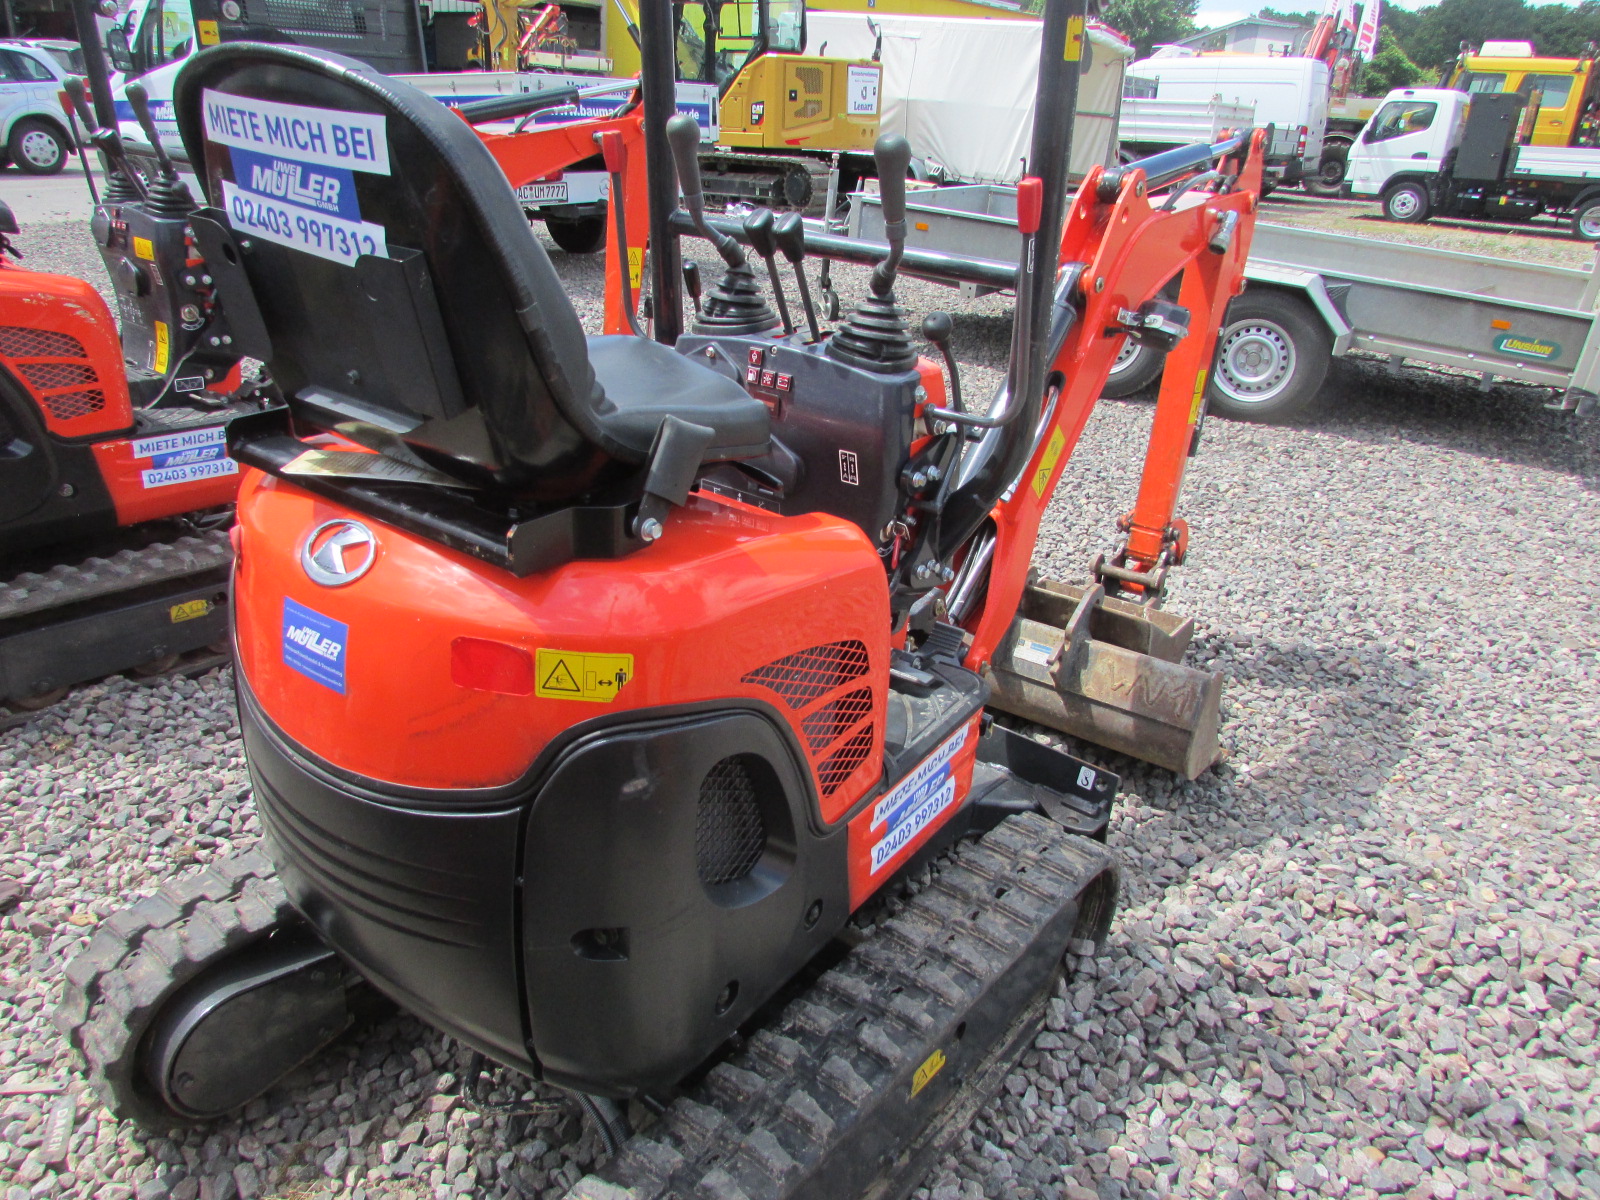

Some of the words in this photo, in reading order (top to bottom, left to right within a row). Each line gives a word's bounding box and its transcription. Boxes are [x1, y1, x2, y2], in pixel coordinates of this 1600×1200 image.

[208, 102, 264, 143] MIETE
[264, 113, 328, 154] MICH
[332, 123, 376, 162] BEI
[273, 160, 296, 176] UWE
[518, 186, 528, 199] AC
[232, 195, 293, 239] 02403
[296, 215, 377, 257] 997312
[139, 438, 179, 454] MIETE
[182, 432, 214, 447] MICH
[148, 468, 187, 484] 02403
[190, 461, 233, 477] 997312
[876, 822, 912, 865] 02403
[914, 786, 952, 829] 997312
